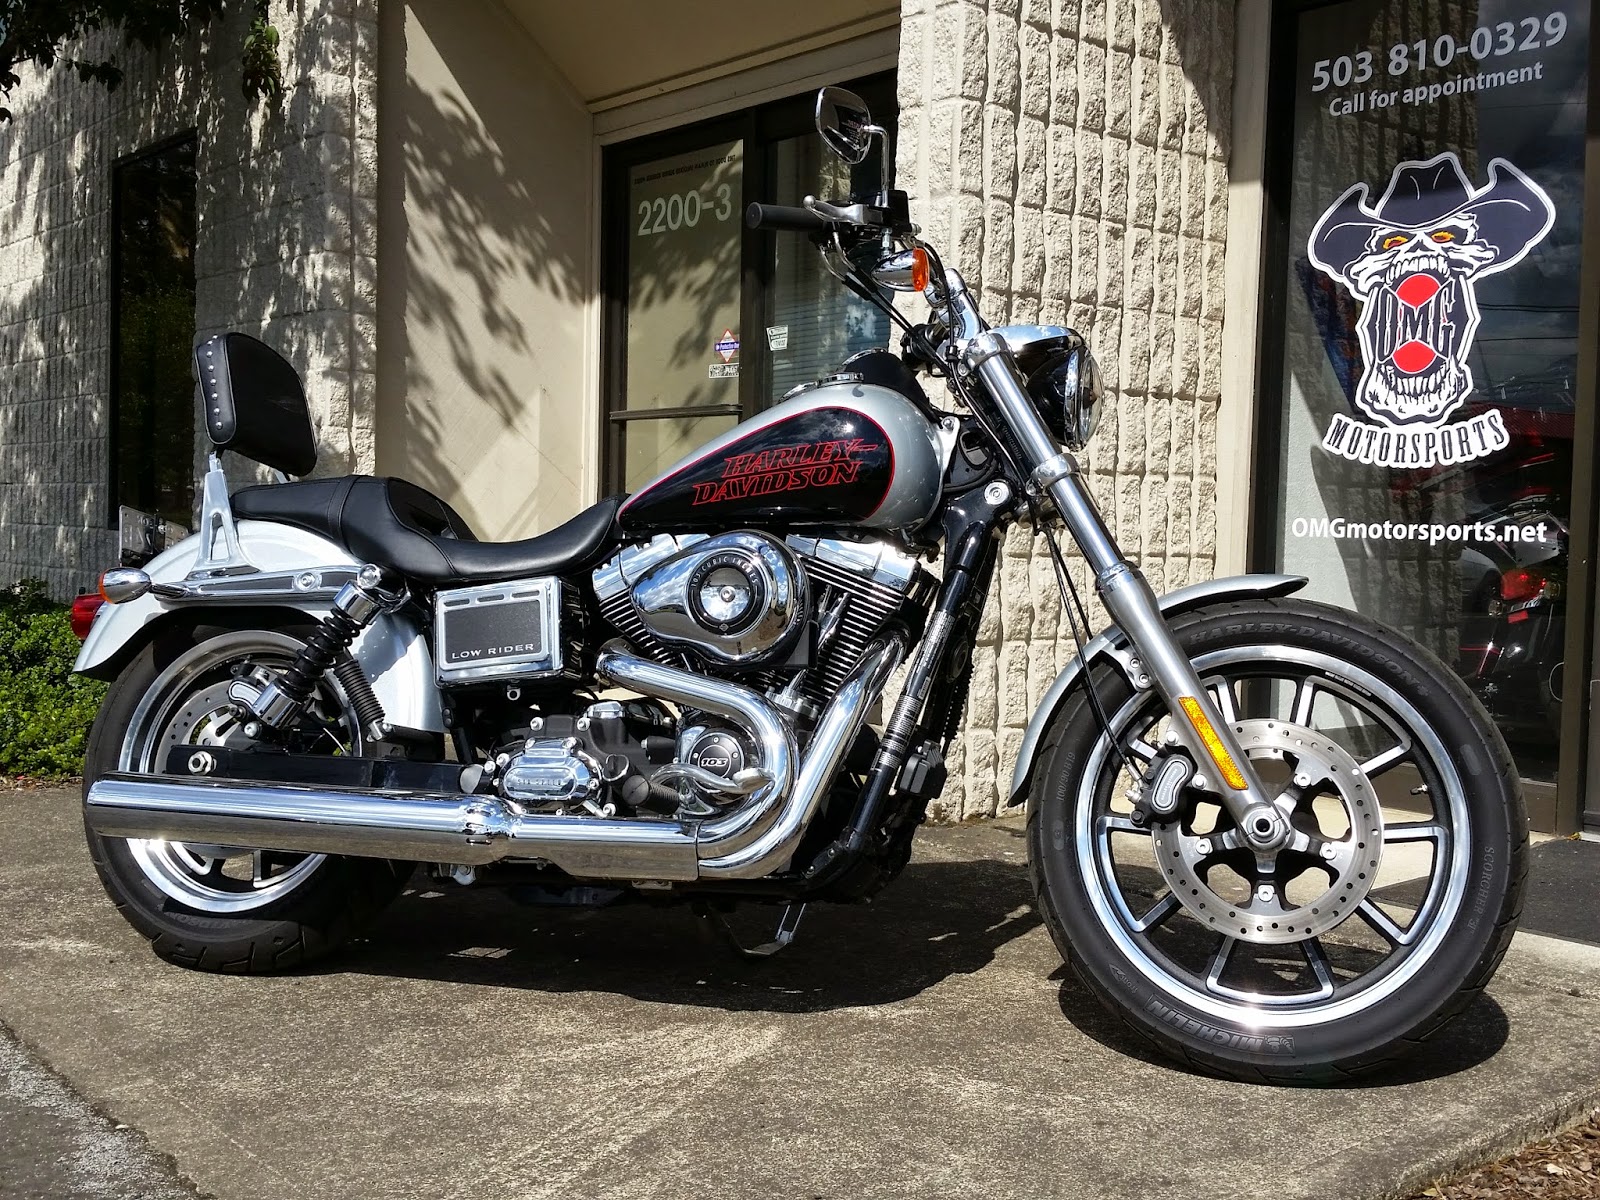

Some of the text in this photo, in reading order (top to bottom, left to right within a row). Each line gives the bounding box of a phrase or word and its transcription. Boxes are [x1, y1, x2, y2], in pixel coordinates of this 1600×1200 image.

[1311, 11, 1568, 92] 503 810-0329
[1329, 62, 1543, 117] Call for appointment
[637, 183, 731, 236] 2200-3
[1376, 277, 1456, 364] OMG
[1326, 414, 1506, 463] MOTORSPORTS
[692, 461, 863, 505] DAVIDSON
[1291, 517, 1548, 545] OMGmotorsports.net
[452, 643, 534, 659] LOW RIDER
[701, 757, 729, 767] 103
[1473, 846, 1495, 916] SCORCHER
[1149, 1000, 1264, 1051] MICHELIN
